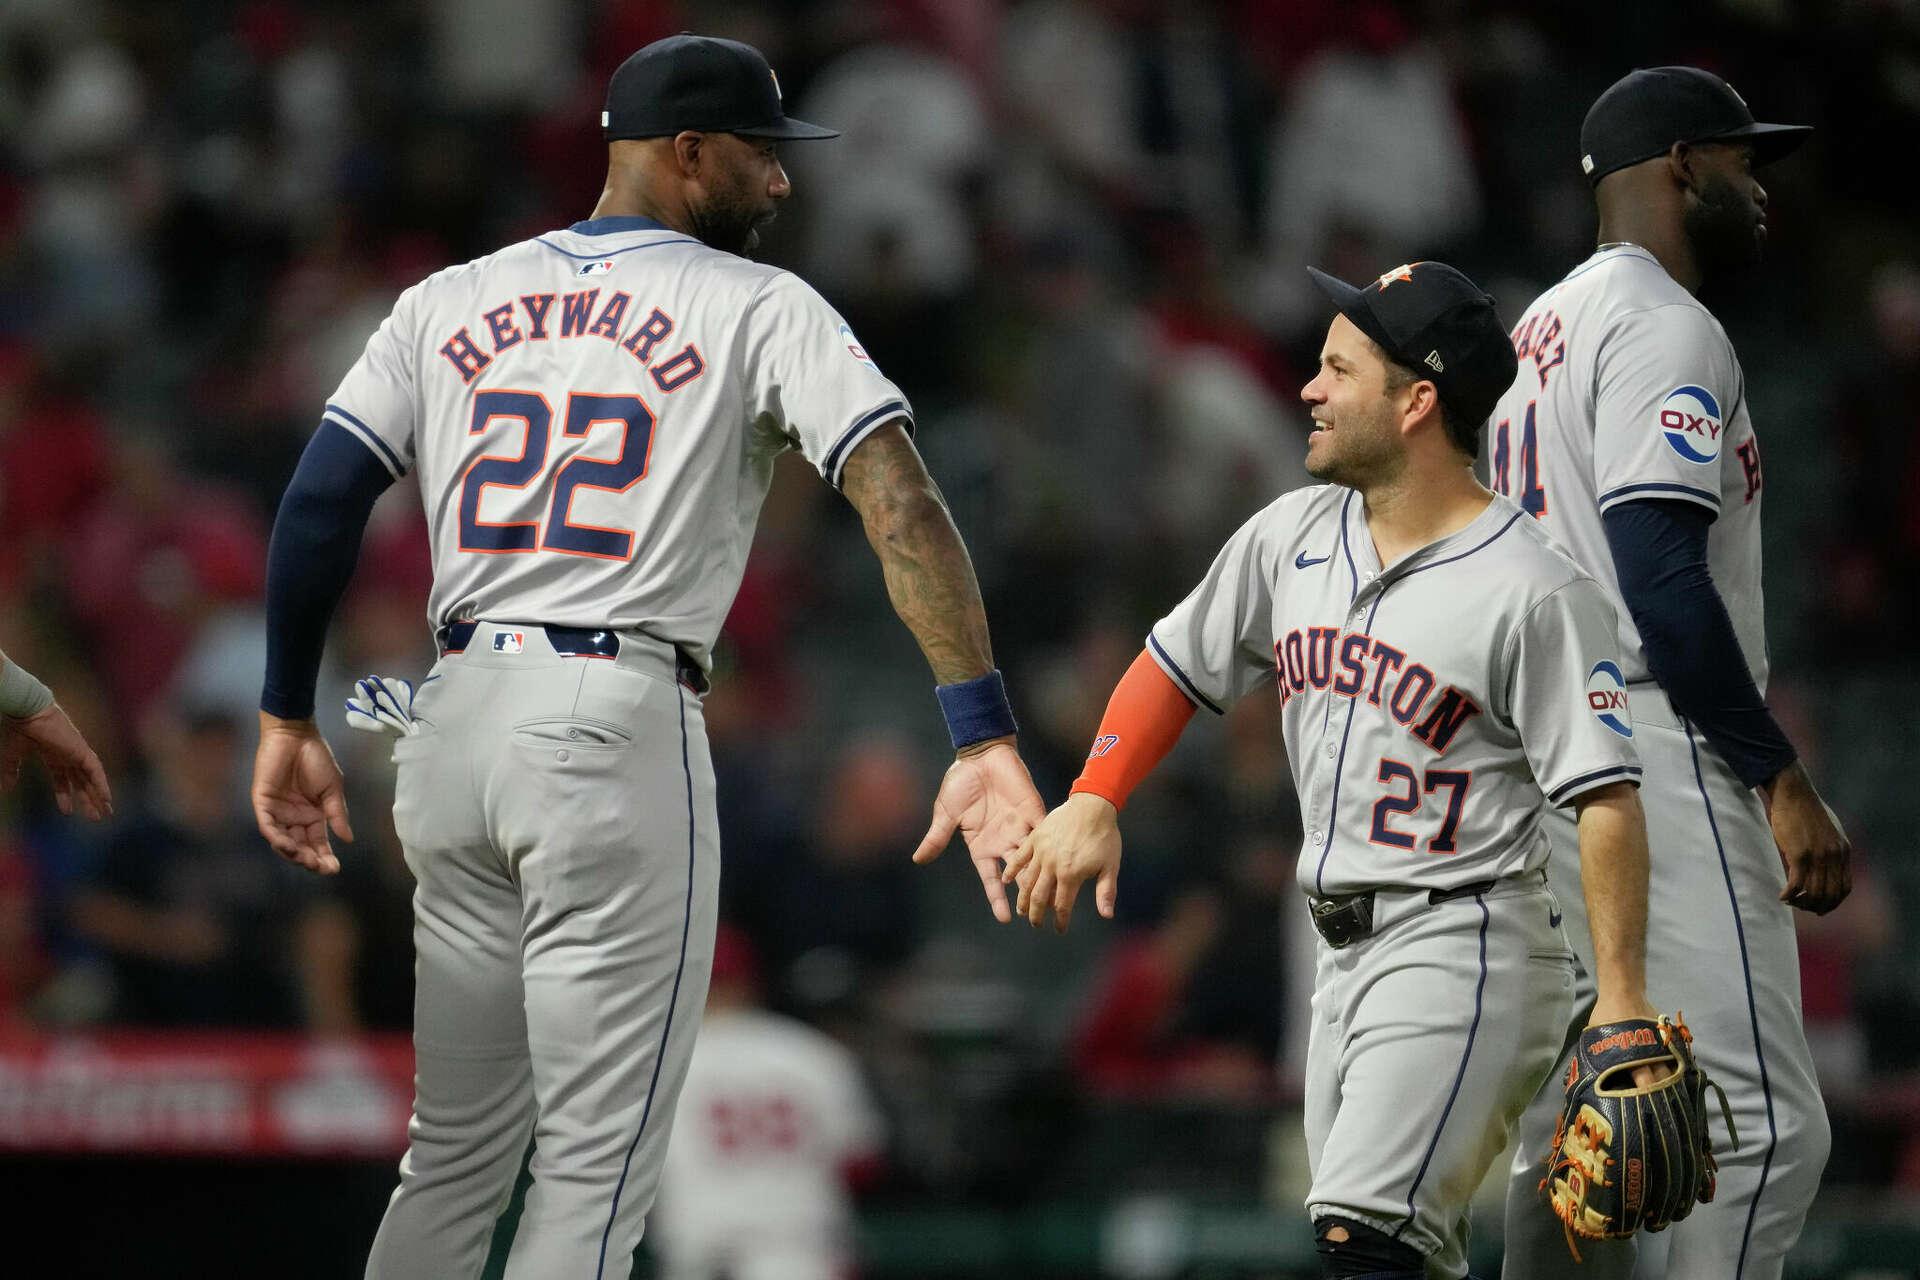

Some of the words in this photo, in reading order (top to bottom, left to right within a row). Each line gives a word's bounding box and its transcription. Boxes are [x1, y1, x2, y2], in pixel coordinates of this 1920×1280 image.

[439, 287, 706, 394] HEYWARD
[1660, 409, 1721, 441] OXY
[458, 389, 657, 562] 22
[1274, 626, 1483, 754] HOUSTON
[1588, 690, 1629, 711] OXY
[1368, 757, 1472, 855] 27
[1591, 1028, 1658, 1056] Wilson
